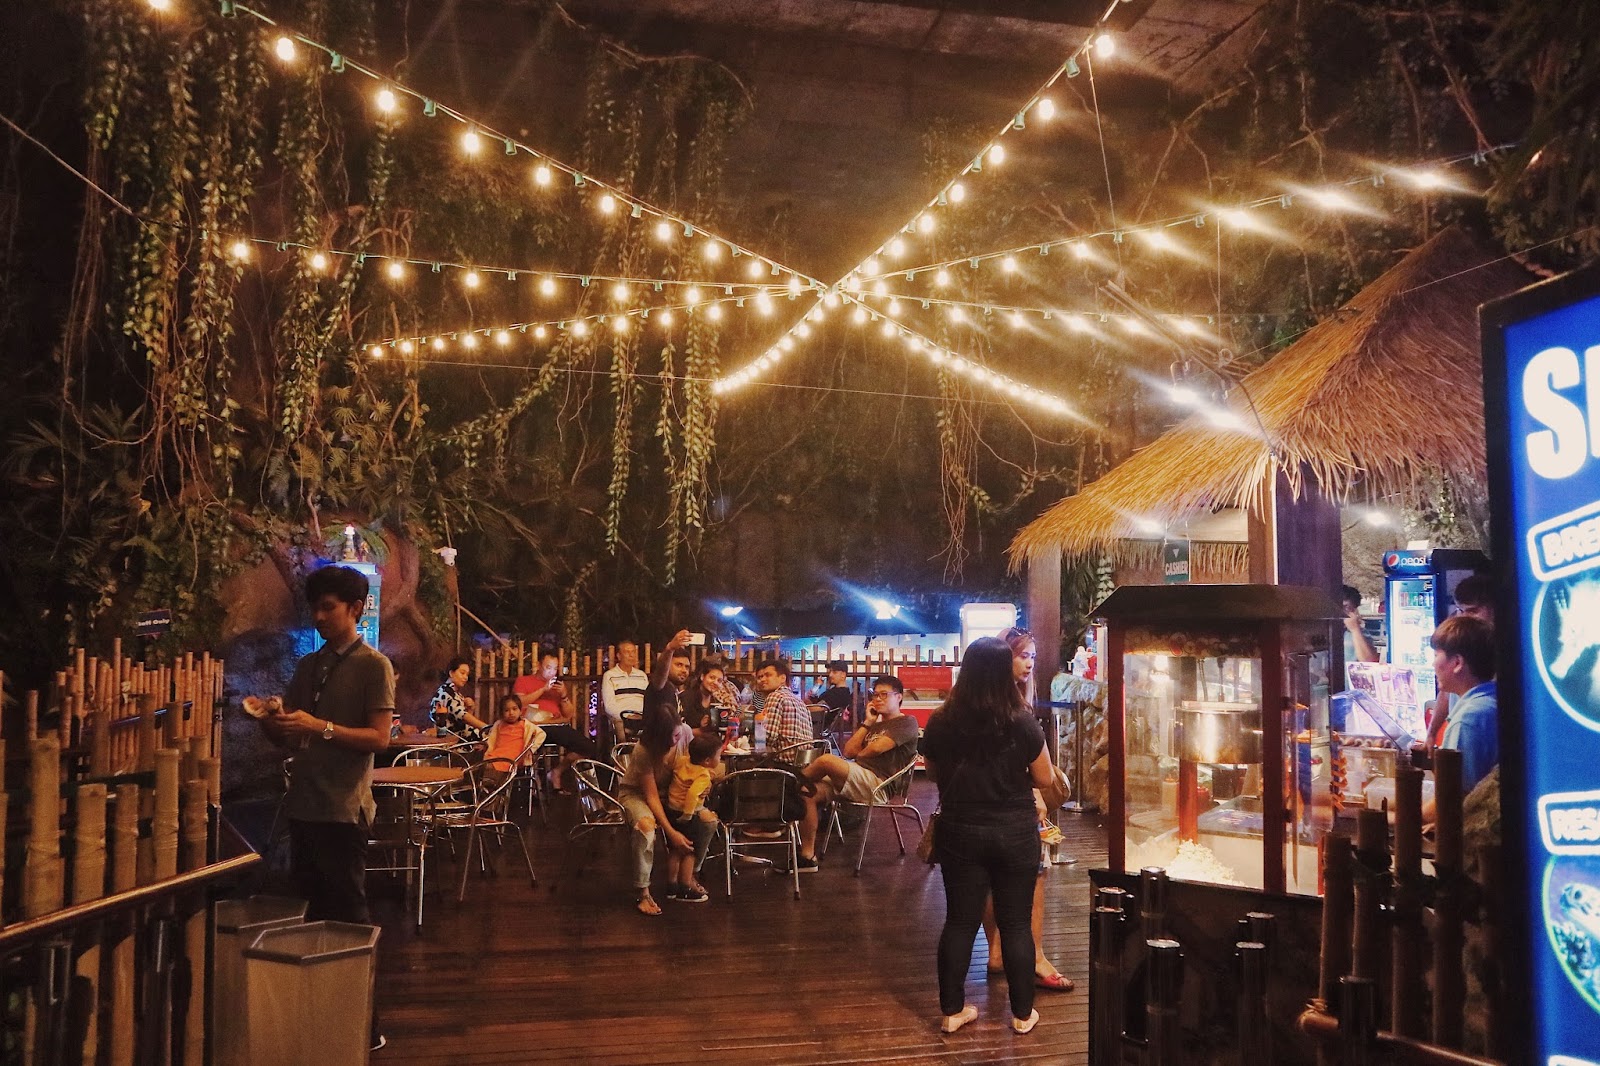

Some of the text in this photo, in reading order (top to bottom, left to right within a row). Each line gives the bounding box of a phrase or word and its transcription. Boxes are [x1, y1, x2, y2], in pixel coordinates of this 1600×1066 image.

[1542, 516, 1600, 567] BRE
[1166, 561, 1188, 575] CASHIER
[1401, 555, 1426, 567] pepsi
[1550, 807, 1600, 840] RES
